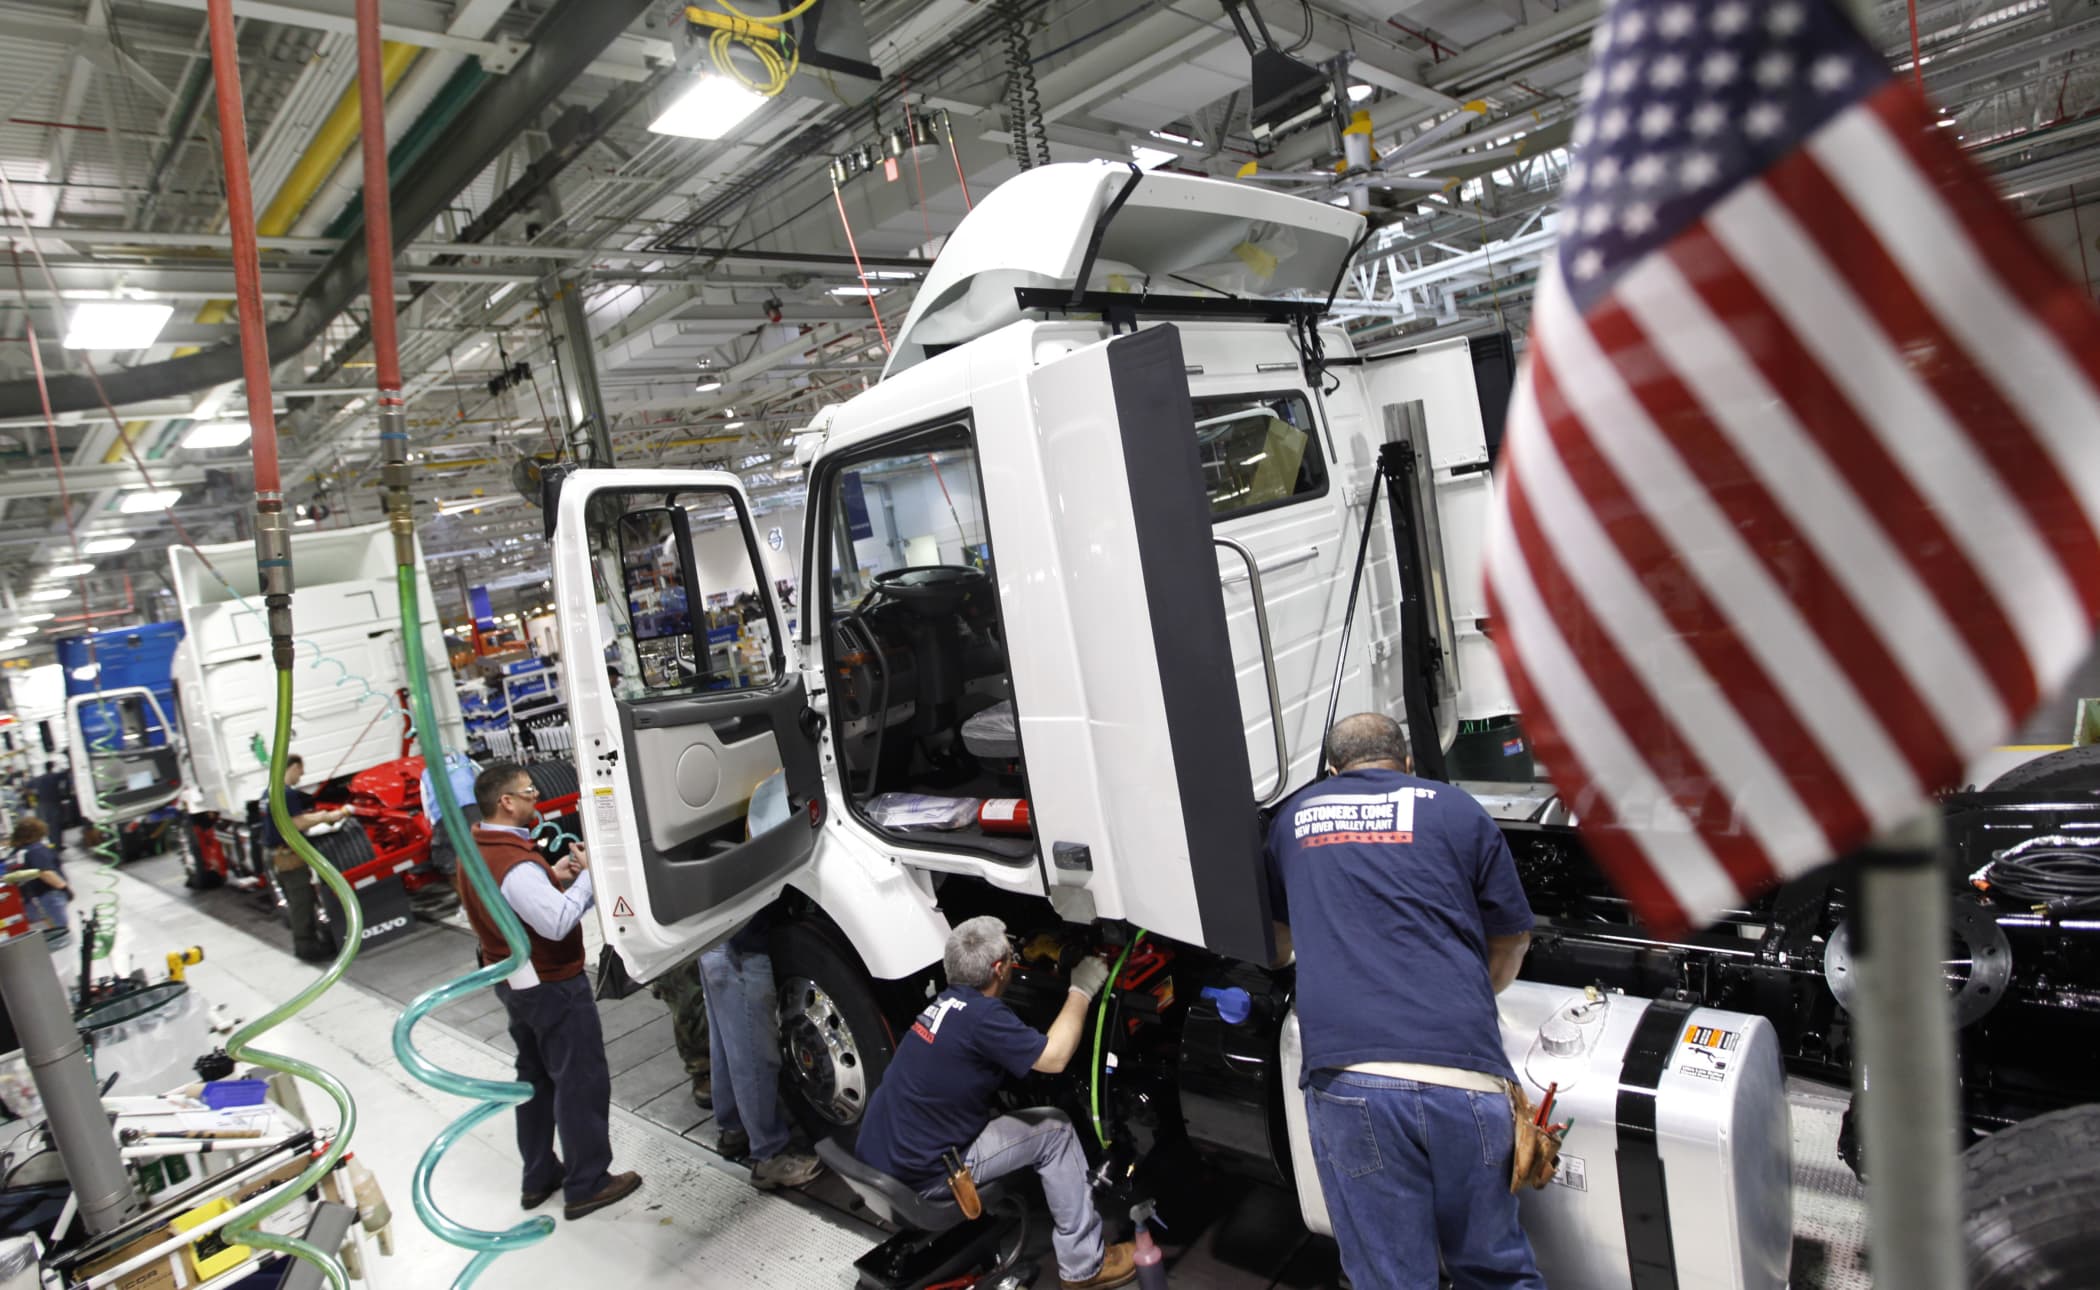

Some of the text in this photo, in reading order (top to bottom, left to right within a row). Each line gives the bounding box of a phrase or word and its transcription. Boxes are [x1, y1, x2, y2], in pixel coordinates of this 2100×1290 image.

[1294, 804, 1359, 826] CUSTOMERS
[1361, 803, 1395, 819] COME
[1294, 818, 1393, 839] NEW RIVER VALLEY PLANT
[361, 916, 408, 940] OLVO
